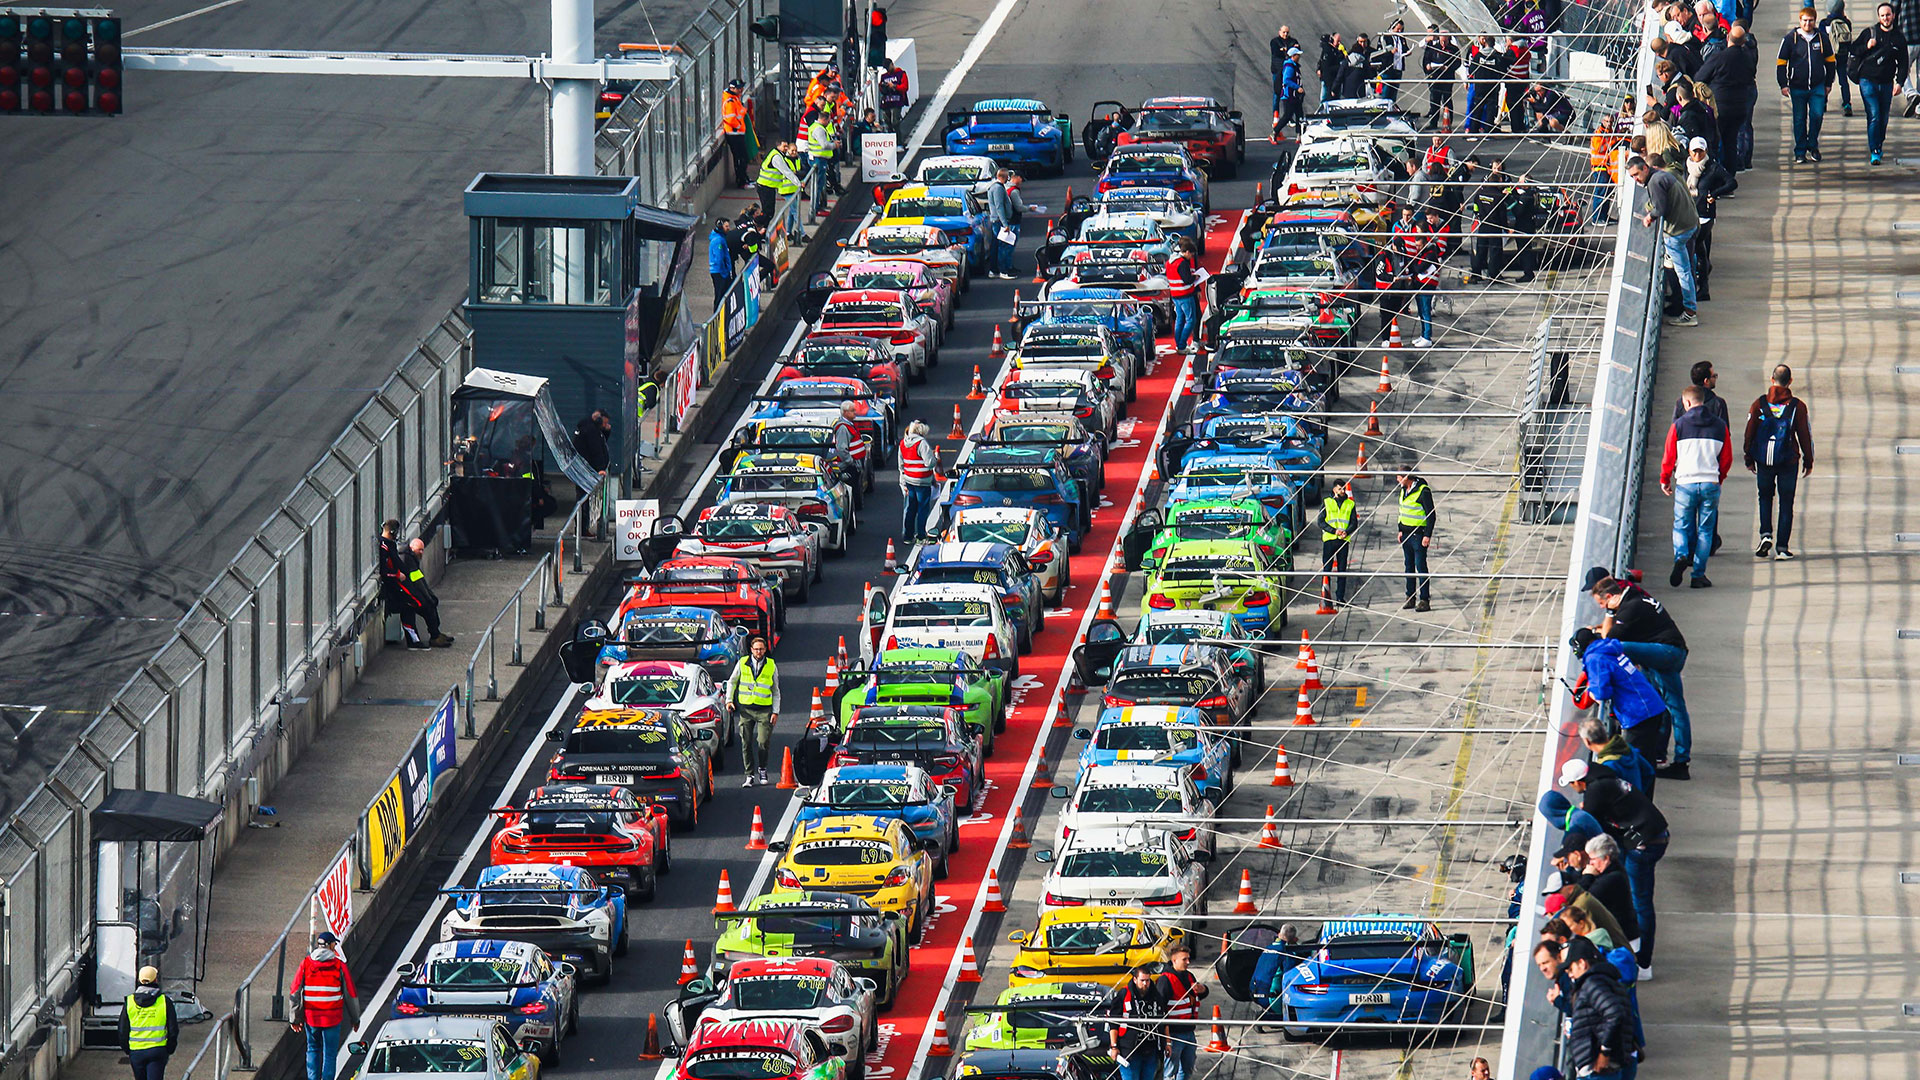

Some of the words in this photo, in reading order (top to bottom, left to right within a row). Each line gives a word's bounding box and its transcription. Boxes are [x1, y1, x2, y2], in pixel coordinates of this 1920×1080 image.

[865, 140, 894, 148] DRIVER
[619, 510, 655, 518] DRIVER
[632, 521, 643, 529] ID
[627, 532, 648, 540] OK?
[850, 839, 882, 849] POOL
[457, 1046, 486, 1061] 511
[749, 1051, 786, 1060] POOL
[762, 1058, 793, 1076] 485
